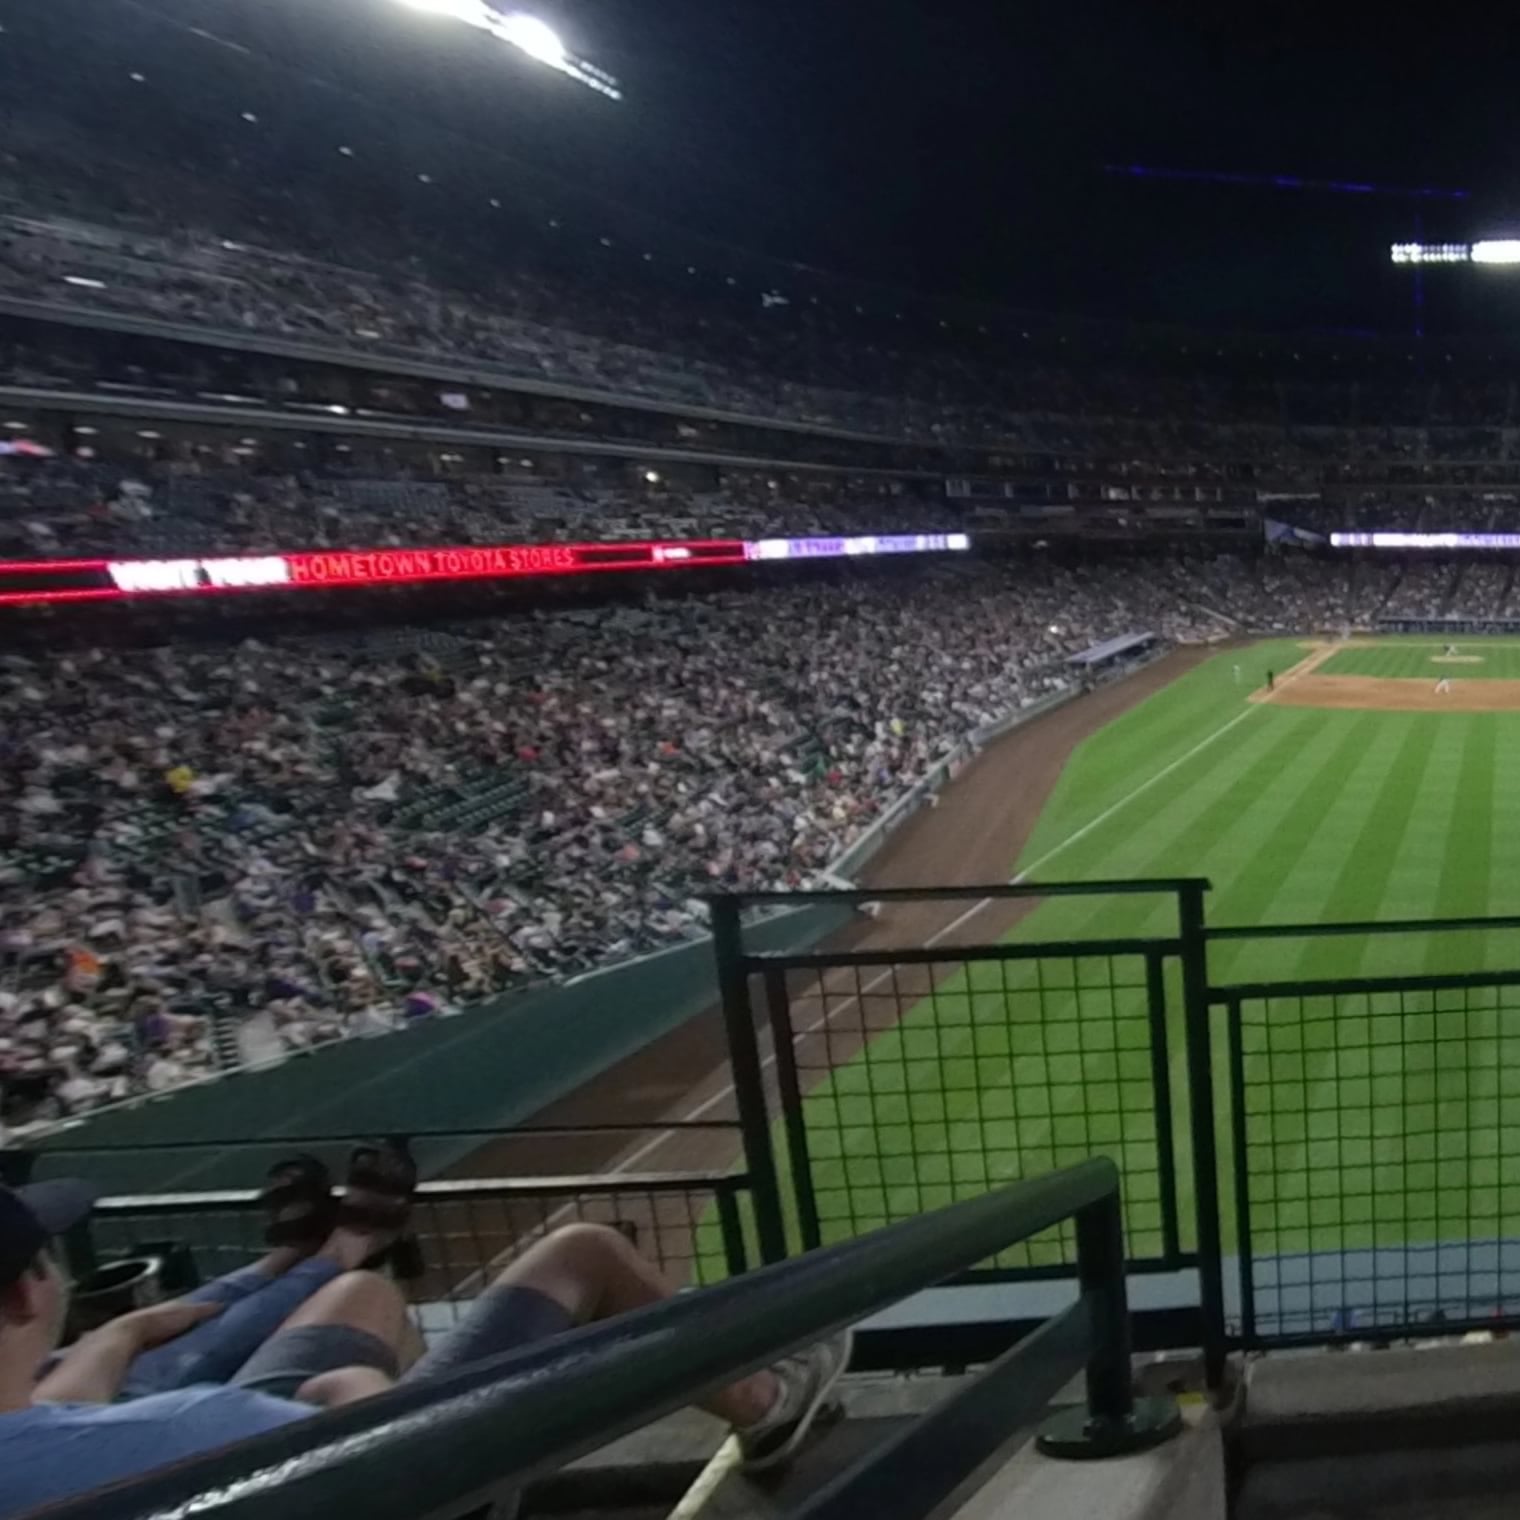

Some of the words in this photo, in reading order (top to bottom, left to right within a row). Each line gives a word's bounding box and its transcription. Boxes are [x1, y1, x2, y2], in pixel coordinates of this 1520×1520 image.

[292, 553, 431, 580] HOMETOWN
[433, 551, 504, 572] TOYOTA
[510, 548, 574, 571] STORES
